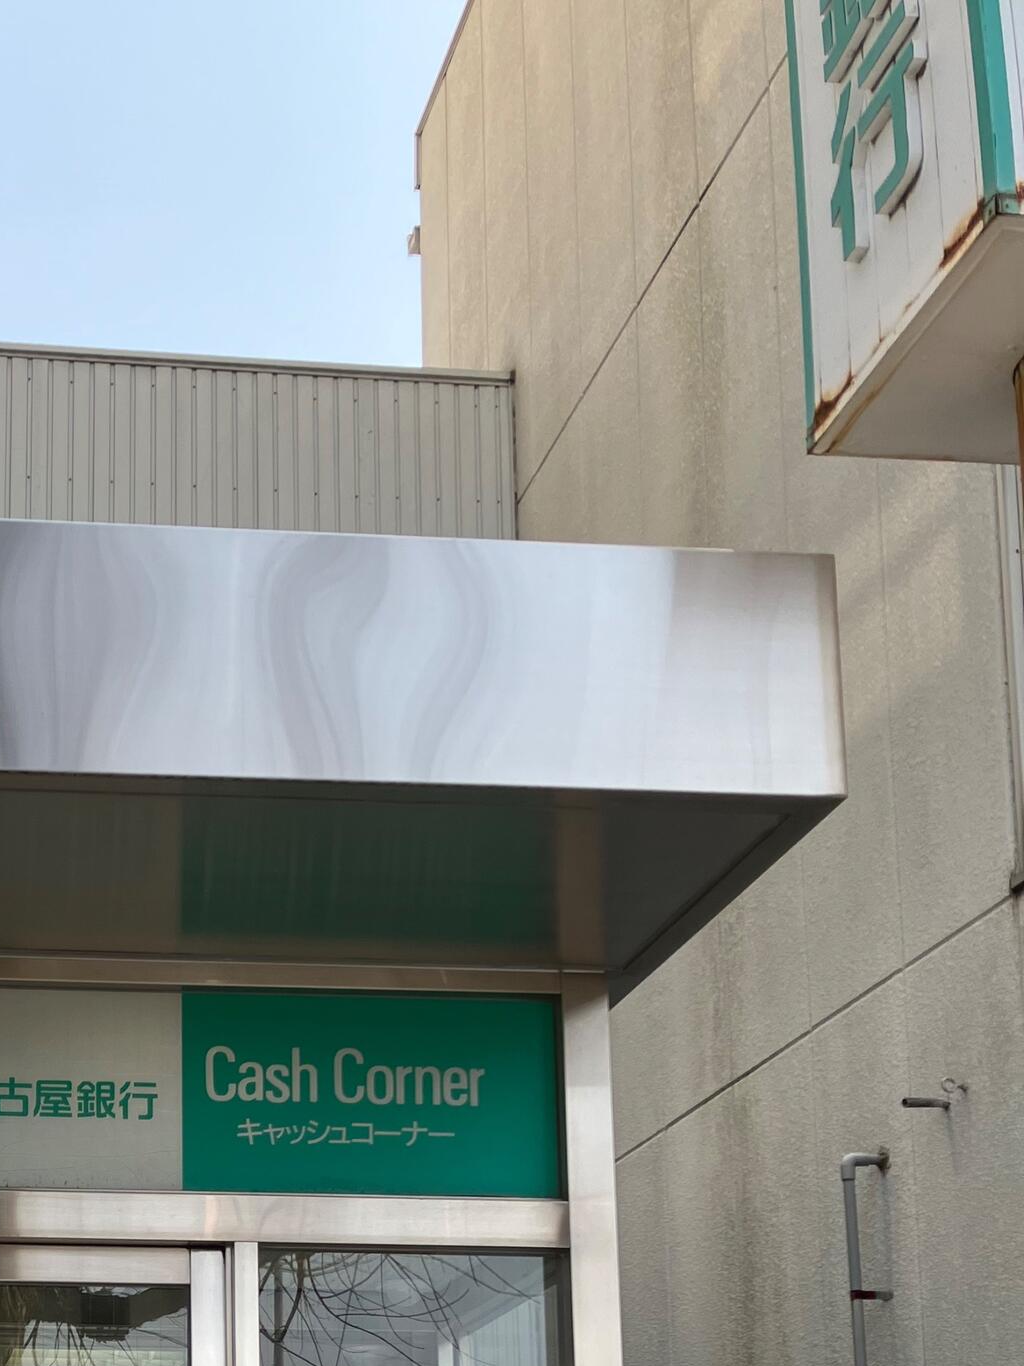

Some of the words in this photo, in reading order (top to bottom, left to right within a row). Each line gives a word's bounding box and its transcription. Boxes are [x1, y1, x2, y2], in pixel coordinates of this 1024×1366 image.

[204, 1045, 318, 1104] Cash
[333, 1048, 486, 1107] Corner
[236, 1117, 456, 1147] キャッシュコーナー
